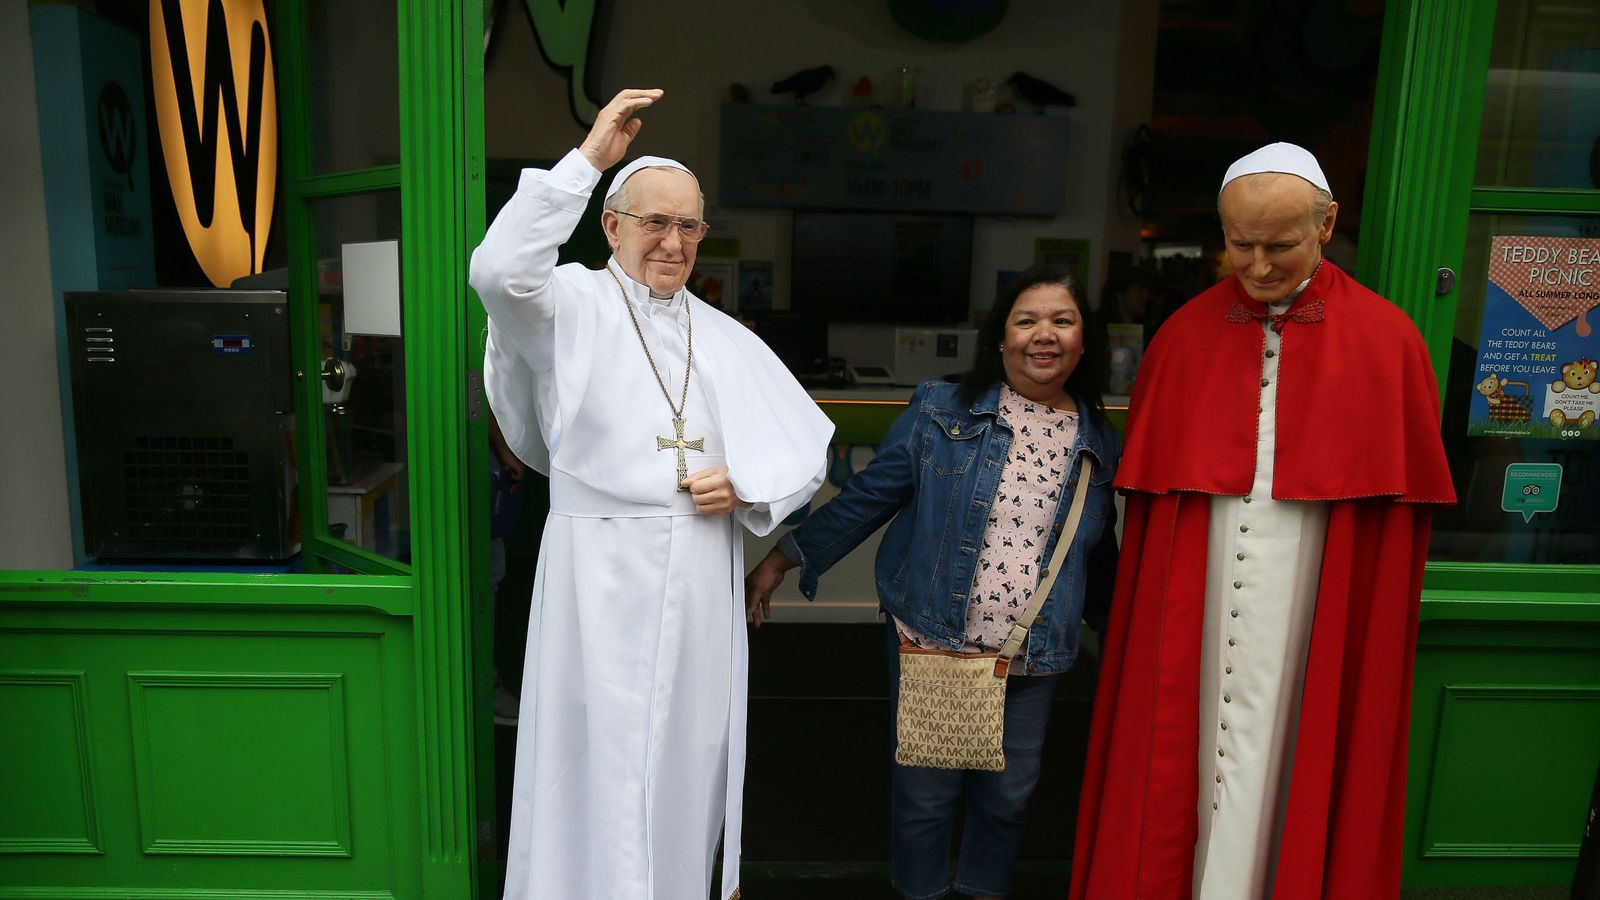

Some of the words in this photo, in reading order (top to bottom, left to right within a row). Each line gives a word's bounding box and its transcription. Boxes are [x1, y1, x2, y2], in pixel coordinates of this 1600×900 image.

[160, 0, 266, 274] W
[104, 192, 122, 213] WAX
[104, 216, 141, 236] MUSEUM
[1501, 246, 1563, 264] TEDDY
[1530, 268, 1594, 286] PICNIC
[1519, 290, 1533, 298] ALL
[1536, 290, 1571, 299] SUMMER
[1574, 292, 1600, 300] LONG
[1502, 328, 1530, 336] COUNT
[1532, 329, 1546, 337] ALL
[1488, 340, 1502, 348] THE
[1505, 340, 1530, 349] TEDDY
[1532, 342, 1556, 350] BEARS
[1530, 354, 1556, 362] TREAT
[1480, 364, 1510, 372] BEFORE
[913, 667, 929, 677] MK
[933, 668, 949, 678] MK
[952, 669, 969, 678] MK
[973, 669, 989, 679] MK
[905, 683, 920, 693] MK
[923, 686, 938, 696] MK
[941, 688, 959, 698] MK
[961, 689, 978, 698] MK
[981, 688, 998, 698] MK
[913, 695, 928, 707] MK
[931, 698, 946, 710] MK
[950, 701, 967, 711] MK
[970, 702, 987, 711] MK
[903, 706, 918, 717] MK
[921, 709, 936, 719] MK
[939, 711, 956, 722] MK
[959, 713, 976, 723] MK
[980, 712, 996, 723] MK
[910, 719, 926, 730] MK
[929, 722, 946, 733] MK
[948, 724, 965, 734] MK
[968, 725, 985, 735] MK
[900, 730, 916, 740] MK
[919, 732, 934, 743] MK
[938, 735, 955, 745] MK
[957, 737, 974, 746] MK
[978, 737, 994, 747] MK
[908, 743, 924, 753] MK
[927, 745, 944, 755] MK
[947, 748, 964, 756] MK
[967, 749, 984, 758] MK
[898, 752, 914, 762] MK
[916, 755, 933, 765] MK
[936, 757, 953, 766] MK
